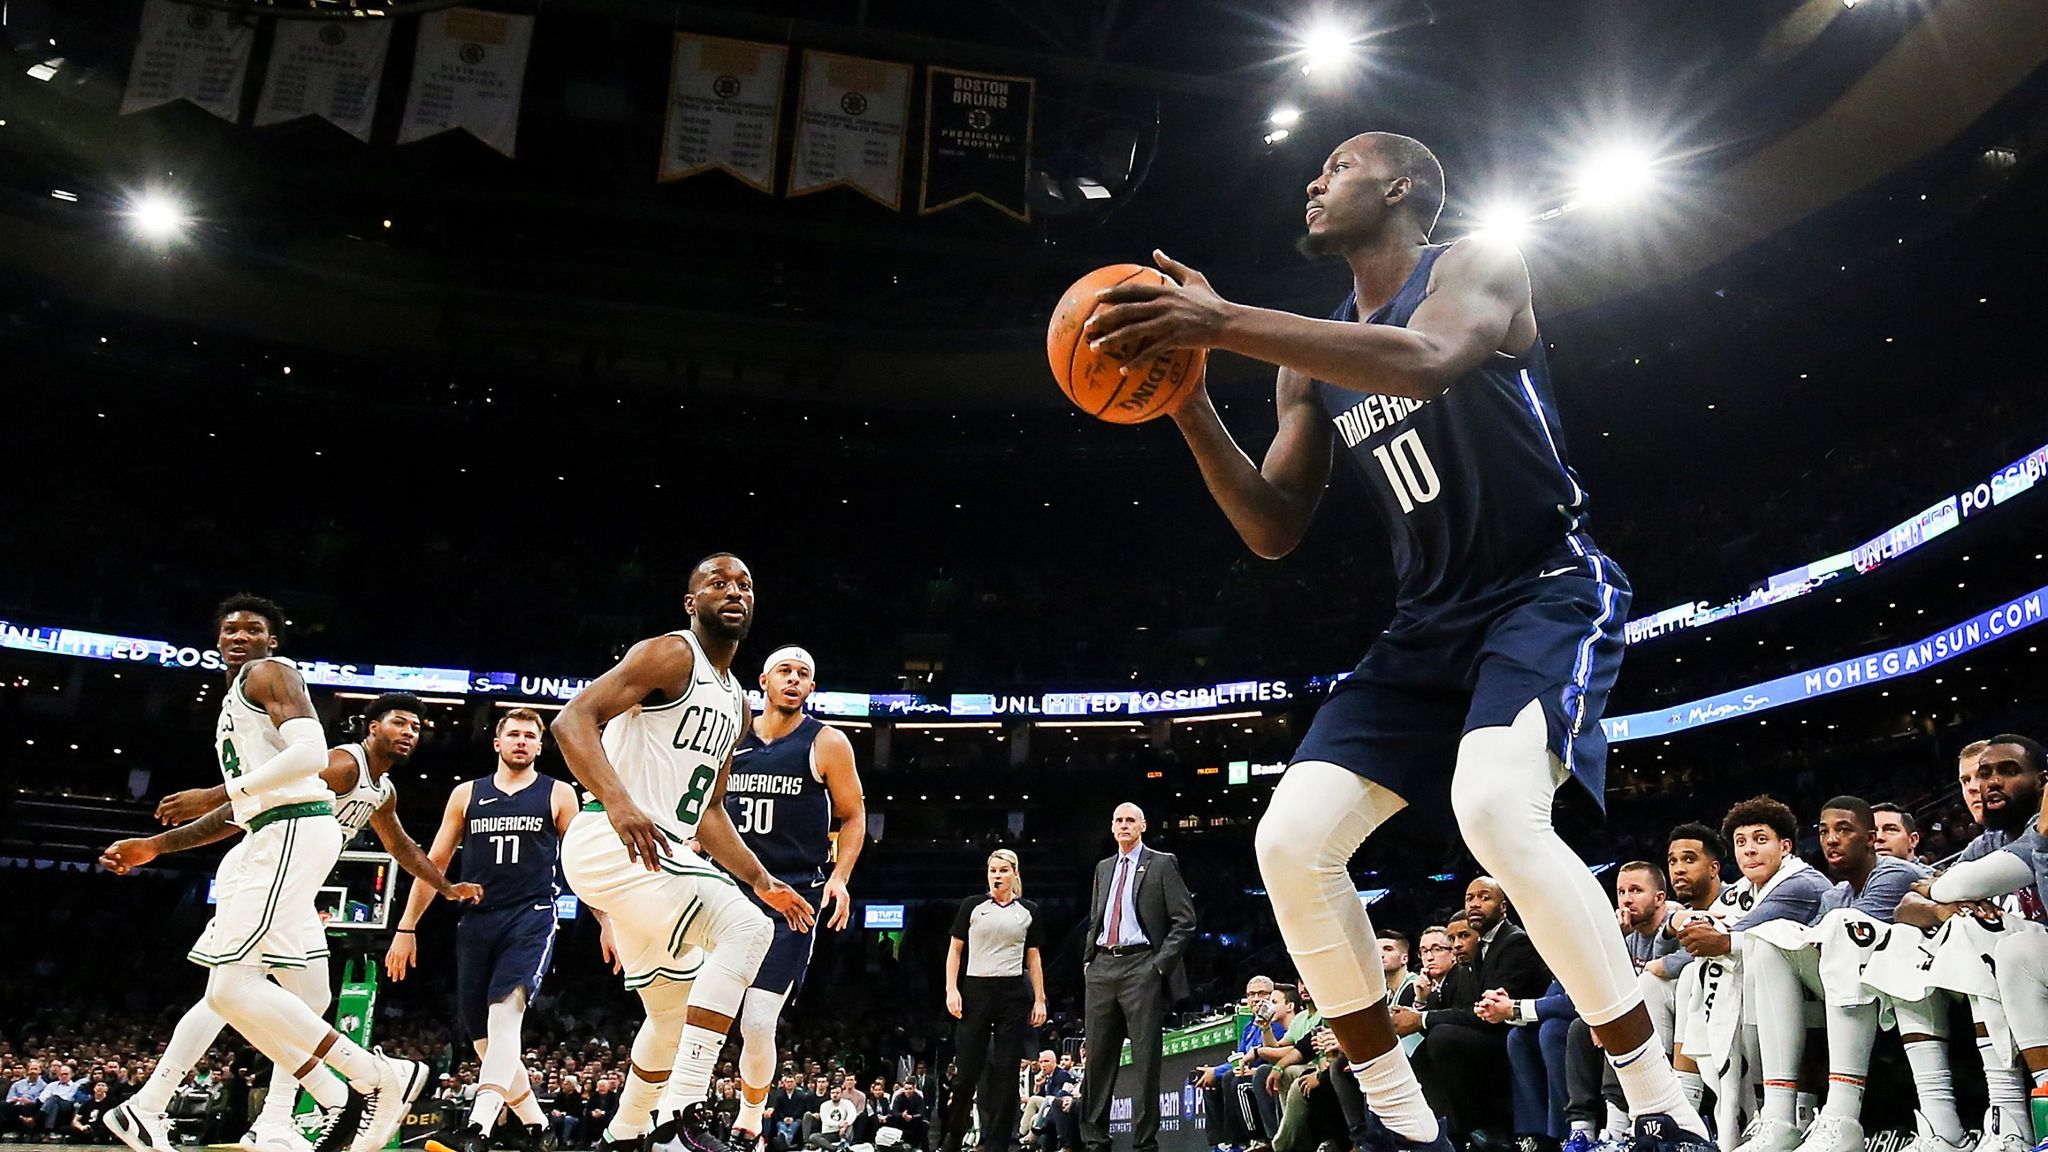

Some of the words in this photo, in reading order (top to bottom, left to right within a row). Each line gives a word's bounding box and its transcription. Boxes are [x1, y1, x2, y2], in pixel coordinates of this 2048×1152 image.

[952, 90, 1008, 109] BRUINS
[954, 76, 1009, 96] BOSTON
[957, 138, 1001, 149] TROPHY
[1333, 393, 1431, 448] MAVERI
[1372, 428, 1441, 514] 10
[1853, 504, 1955, 573] UNLIMITED
[1961, 447, 2048, 518] POSSIBI
[1805, 595, 2041, 694] MOHEGANSUN.COM
[990, 695, 1121, 715] UNLIMITED
[1129, 681, 1293, 714] POSSIBILITIES.
[1688, 703, 1742, 724] Mohegan
[1742, 694, 1770, 711] Sun
[1251, 761, 1287, 776] Bank
[675, 763, 716, 826] 8
[470, 816, 544, 835] MAVERICKS
[737, 796, 775, 835] 30
[488, 835, 521, 865] 77
